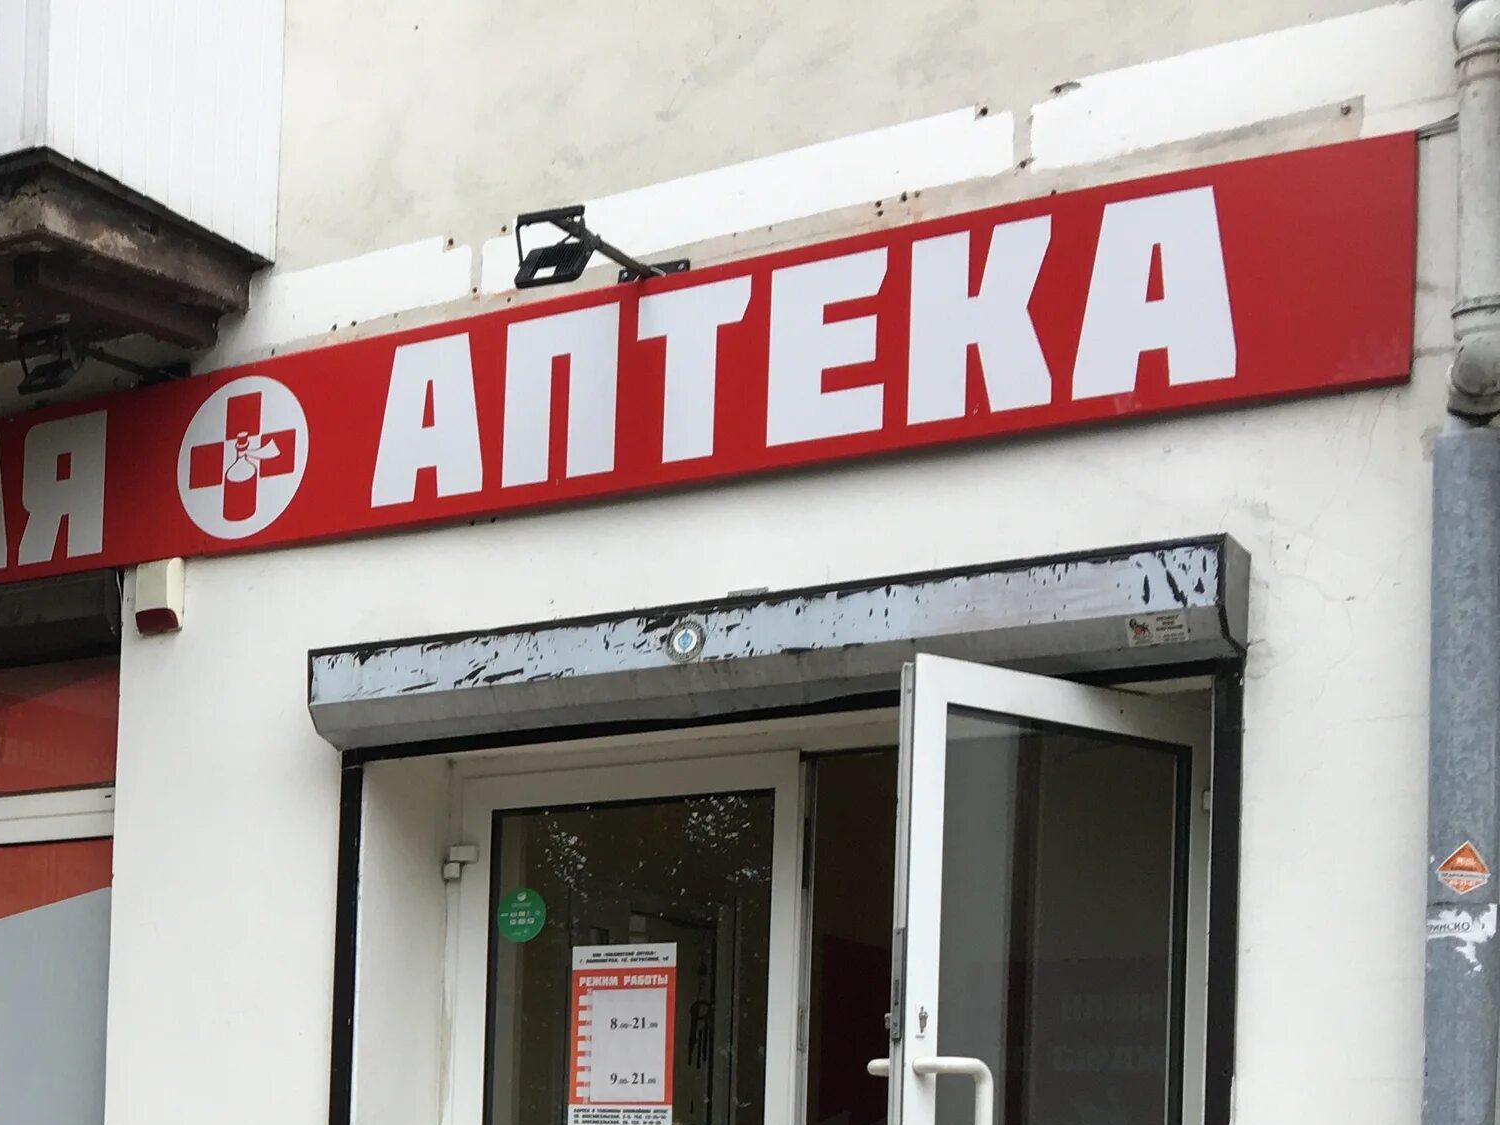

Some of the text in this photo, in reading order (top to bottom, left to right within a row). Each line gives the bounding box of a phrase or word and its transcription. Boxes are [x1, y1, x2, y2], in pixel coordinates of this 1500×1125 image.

[371, 186, 1237, 509] АПТЕКА
[579, 974, 668, 987] РЕЖИМ РАБОТЫ
